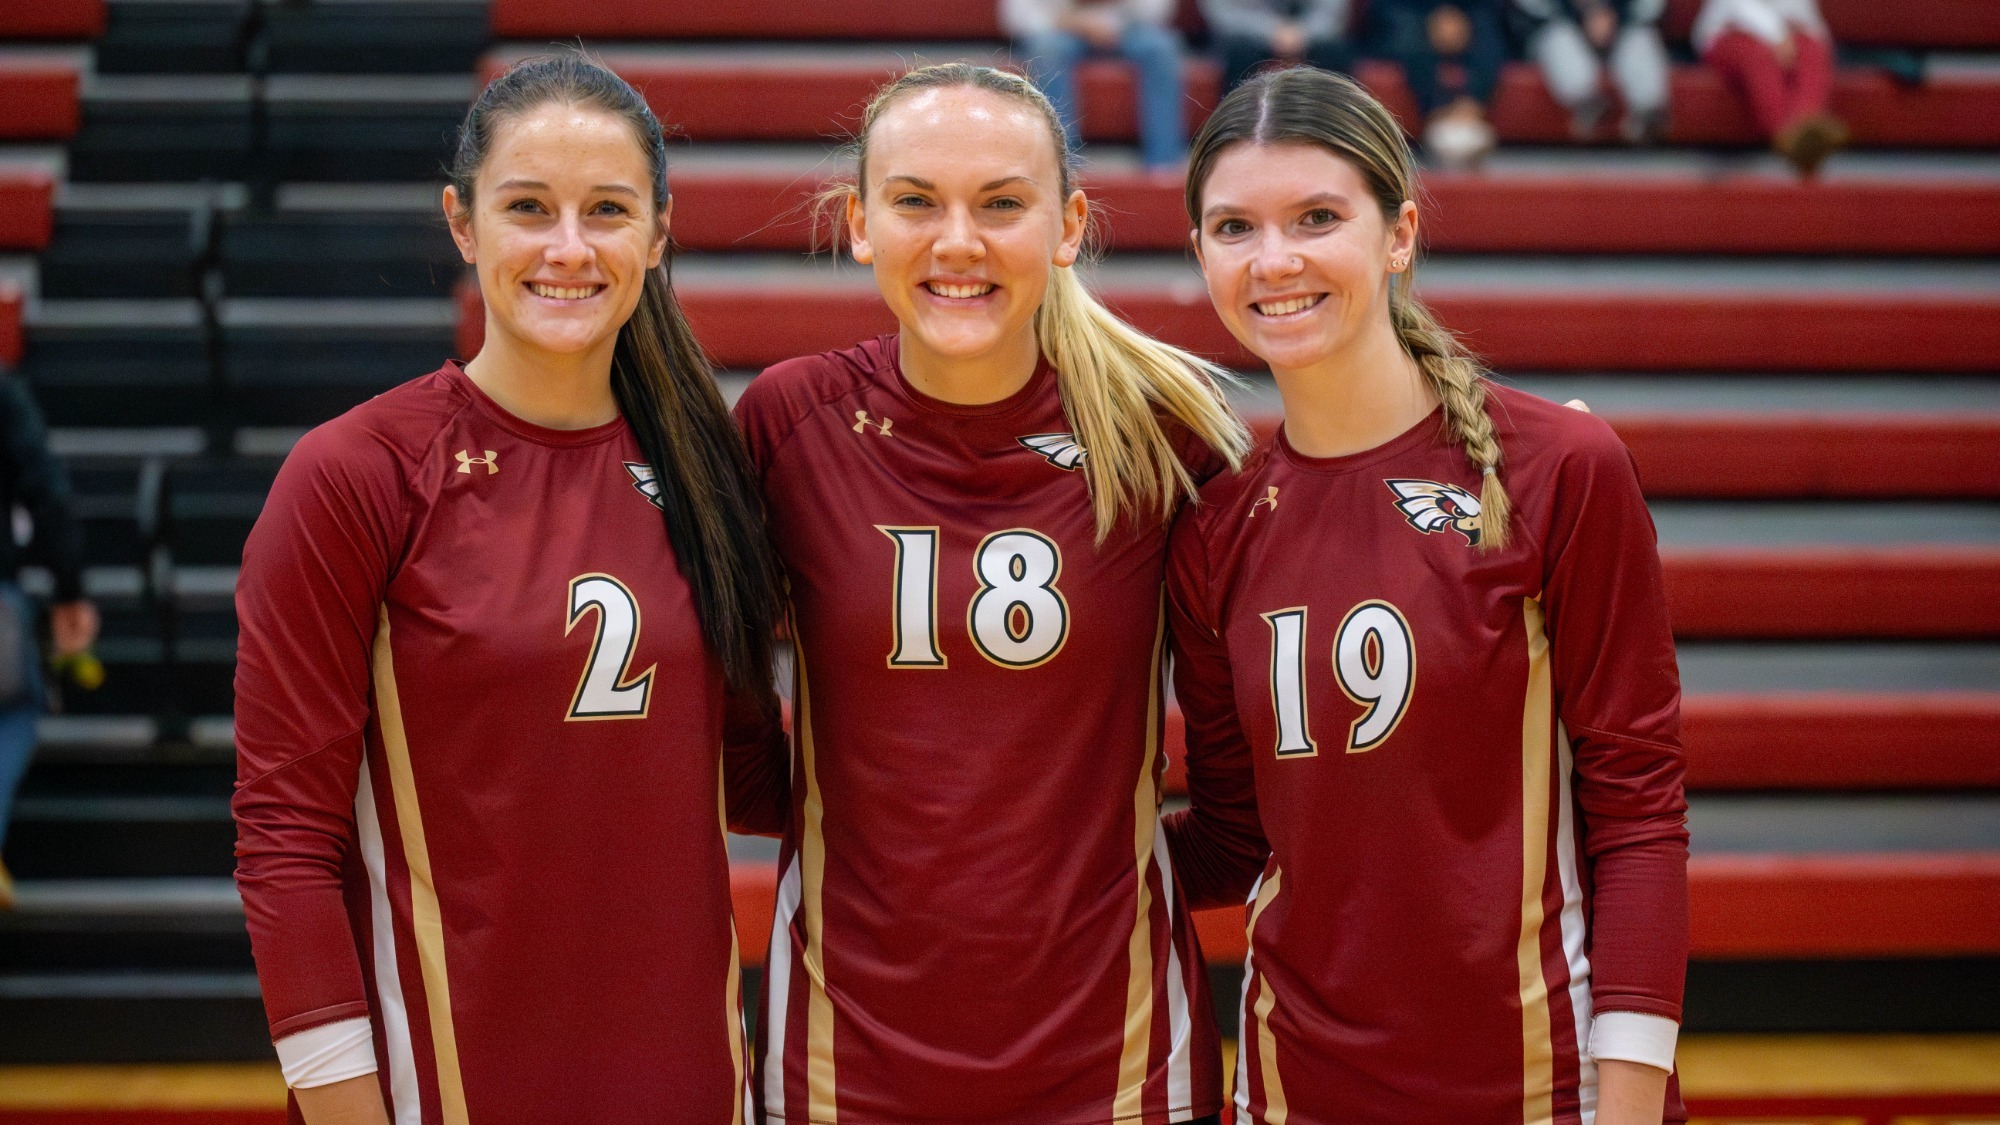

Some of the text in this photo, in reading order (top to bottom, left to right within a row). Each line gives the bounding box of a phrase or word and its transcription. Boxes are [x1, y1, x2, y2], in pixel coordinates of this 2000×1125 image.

[564, 572, 657, 722] 2
[873, 525, 1070, 670] 18
[1259, 599, 1417, 760] 19
